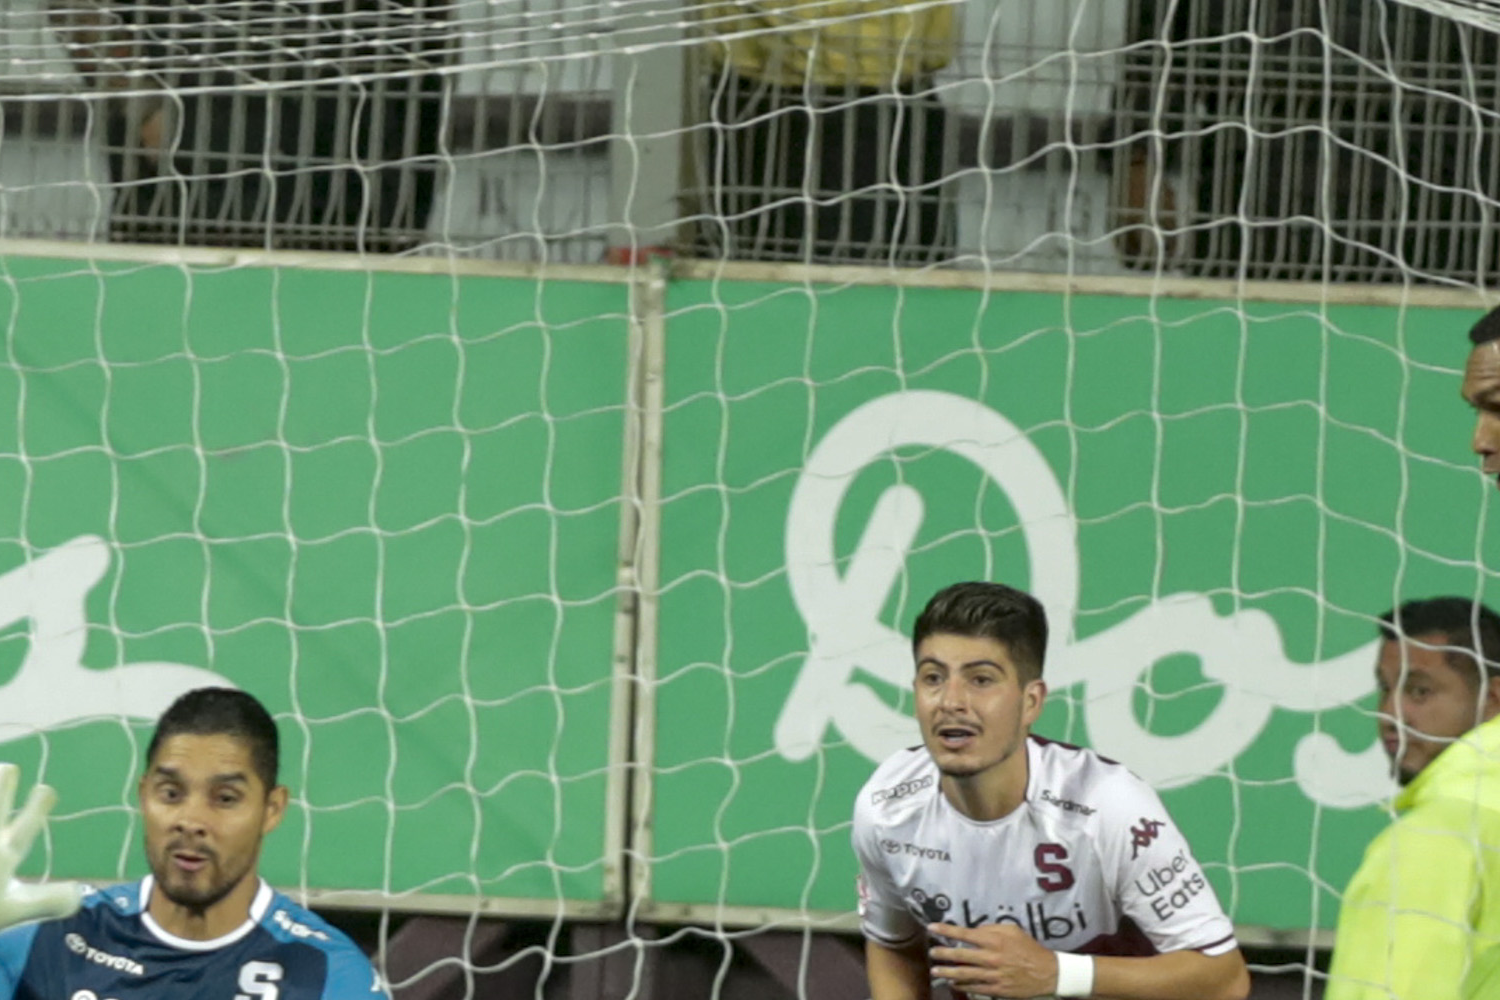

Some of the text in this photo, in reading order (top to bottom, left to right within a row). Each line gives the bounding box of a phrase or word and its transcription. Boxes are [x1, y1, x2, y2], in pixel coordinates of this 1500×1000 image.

[1033, 842, 1076, 894] S
[1149, 870, 1206, 922] Eats
[84, 946, 145, 976] TOYOTA
